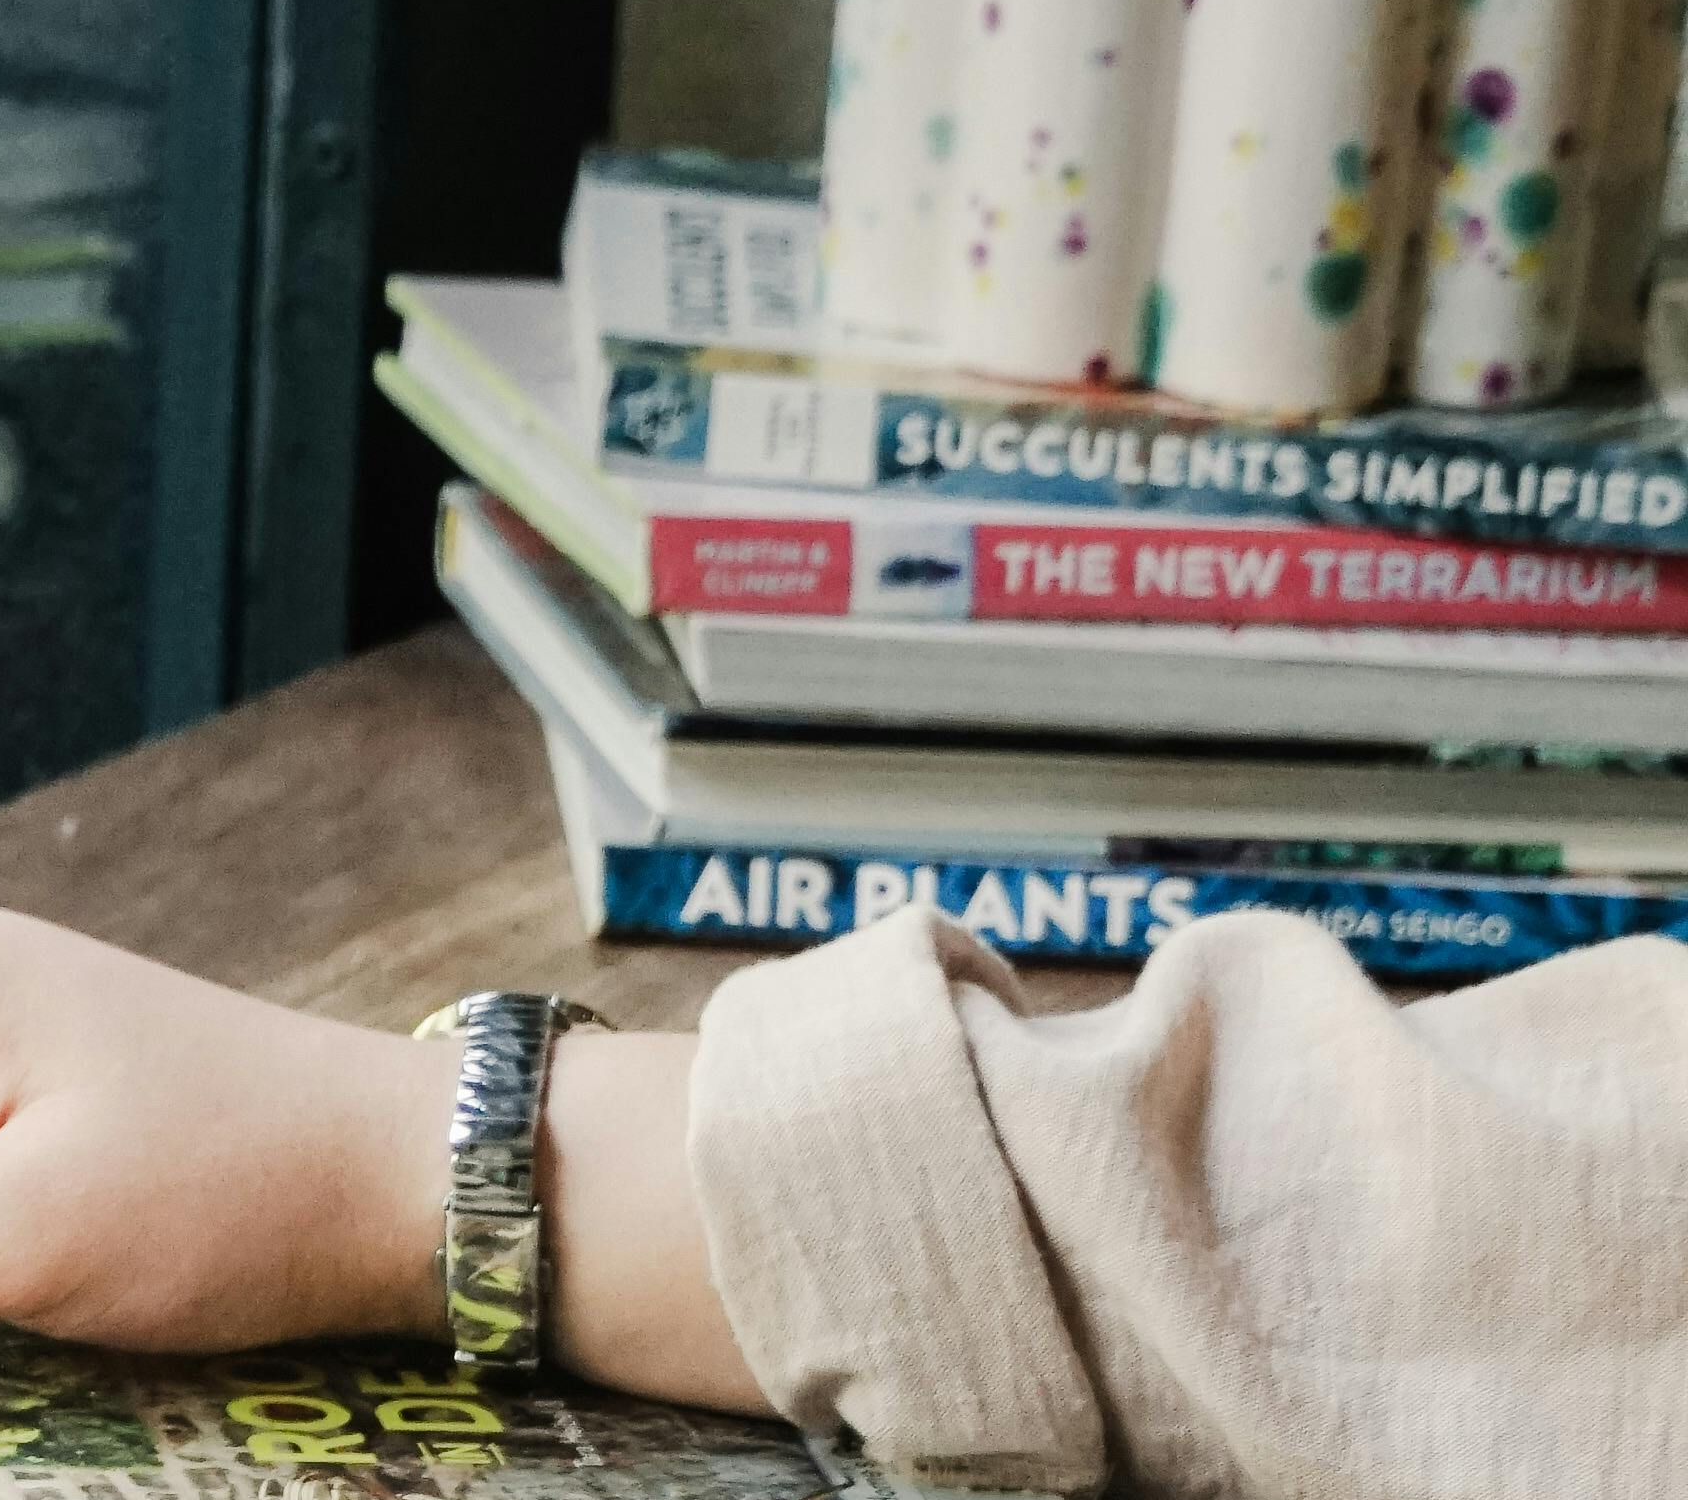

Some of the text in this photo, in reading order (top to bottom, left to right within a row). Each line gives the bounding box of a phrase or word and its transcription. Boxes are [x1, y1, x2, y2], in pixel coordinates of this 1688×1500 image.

[892, 411, 1309, 499] SUCCULENTS
[1322, 447, 1687, 528] SIMPLIFIED
[992, 541, 1656, 610] THE NEW TERRARIUM
[678, 856, 835, 932] AIR
